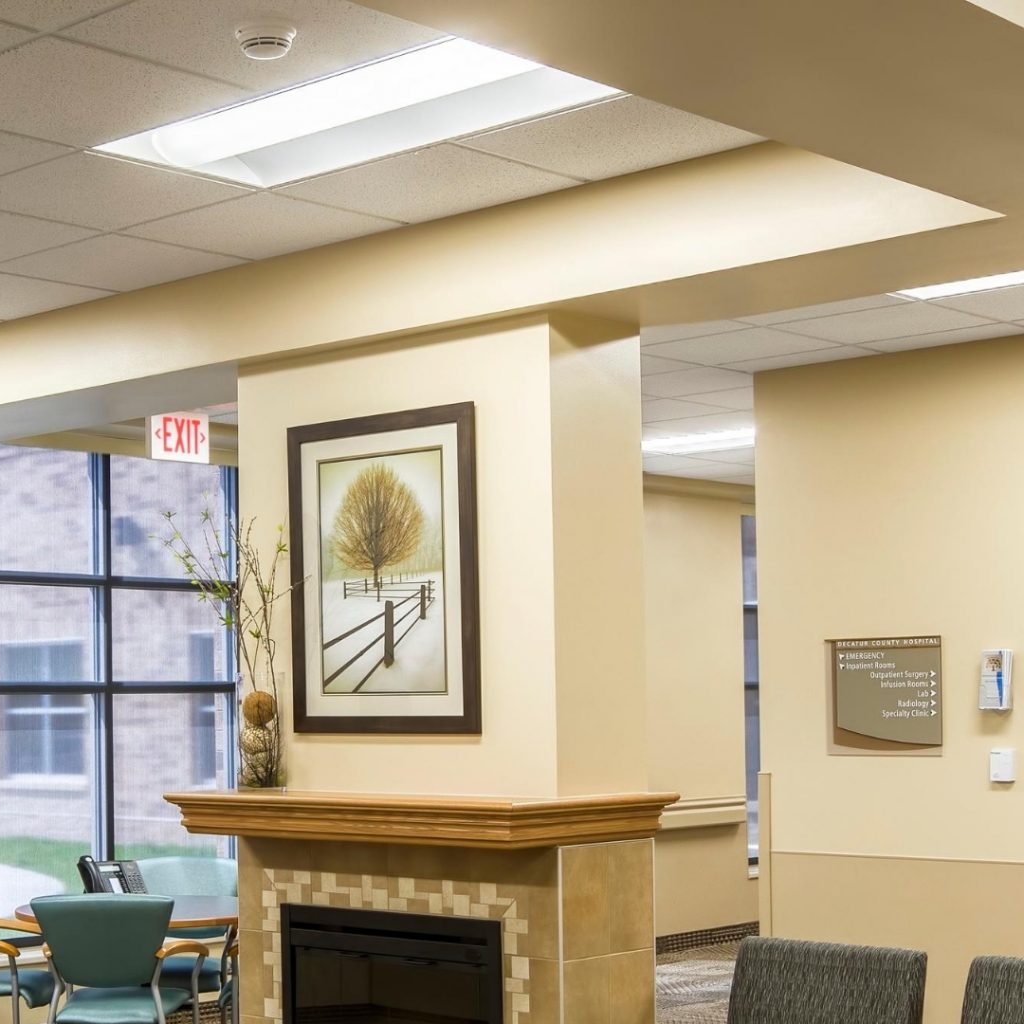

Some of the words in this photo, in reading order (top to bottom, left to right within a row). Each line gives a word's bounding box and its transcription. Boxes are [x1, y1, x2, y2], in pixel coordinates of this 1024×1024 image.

[163, 416, 201, 455] EXIT
[846, 652, 885, 660] EMERGENCY
[846, 662, 873, 670] Inpatient
[874, 661, 896, 669] Rooms
[870, 671, 904, 680] Outpatient
[904, 670, 929, 679] Surgery
[880, 680, 906, 688] Infusion
[907, 680, 929, 688] Rooms
[917, 690, 929, 698] Lab
[897, 699, 929, 709] Radiology
[881, 709, 910, 719] Specialty
[911, 709, 929, 717] Clinic
